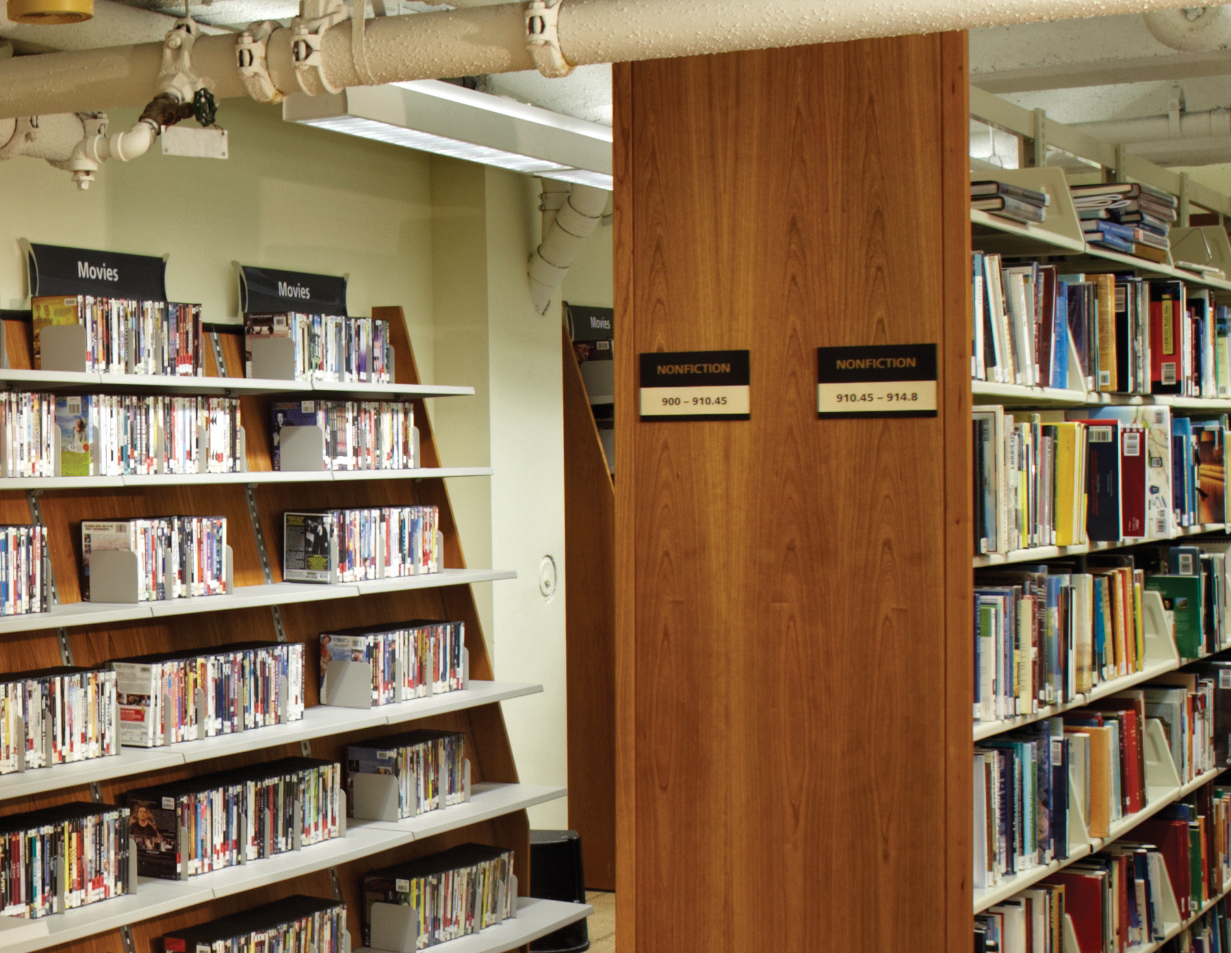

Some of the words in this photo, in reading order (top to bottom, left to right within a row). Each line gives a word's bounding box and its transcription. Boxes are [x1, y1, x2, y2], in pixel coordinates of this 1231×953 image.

[77, 261, 119, 282] Movies
[278, 281, 311, 300] Movies
[590, 316, 611, 330] Movies
[657, 363, 731, 375] NONFICTION
[836, 357, 916, 370] NONFICTION
[662, 397, 681, 406] 900
[692, 396, 727, 406] 910.45
[836, 393, 874, 403] 910.45
[886, 392, 918, 402] 914.8
